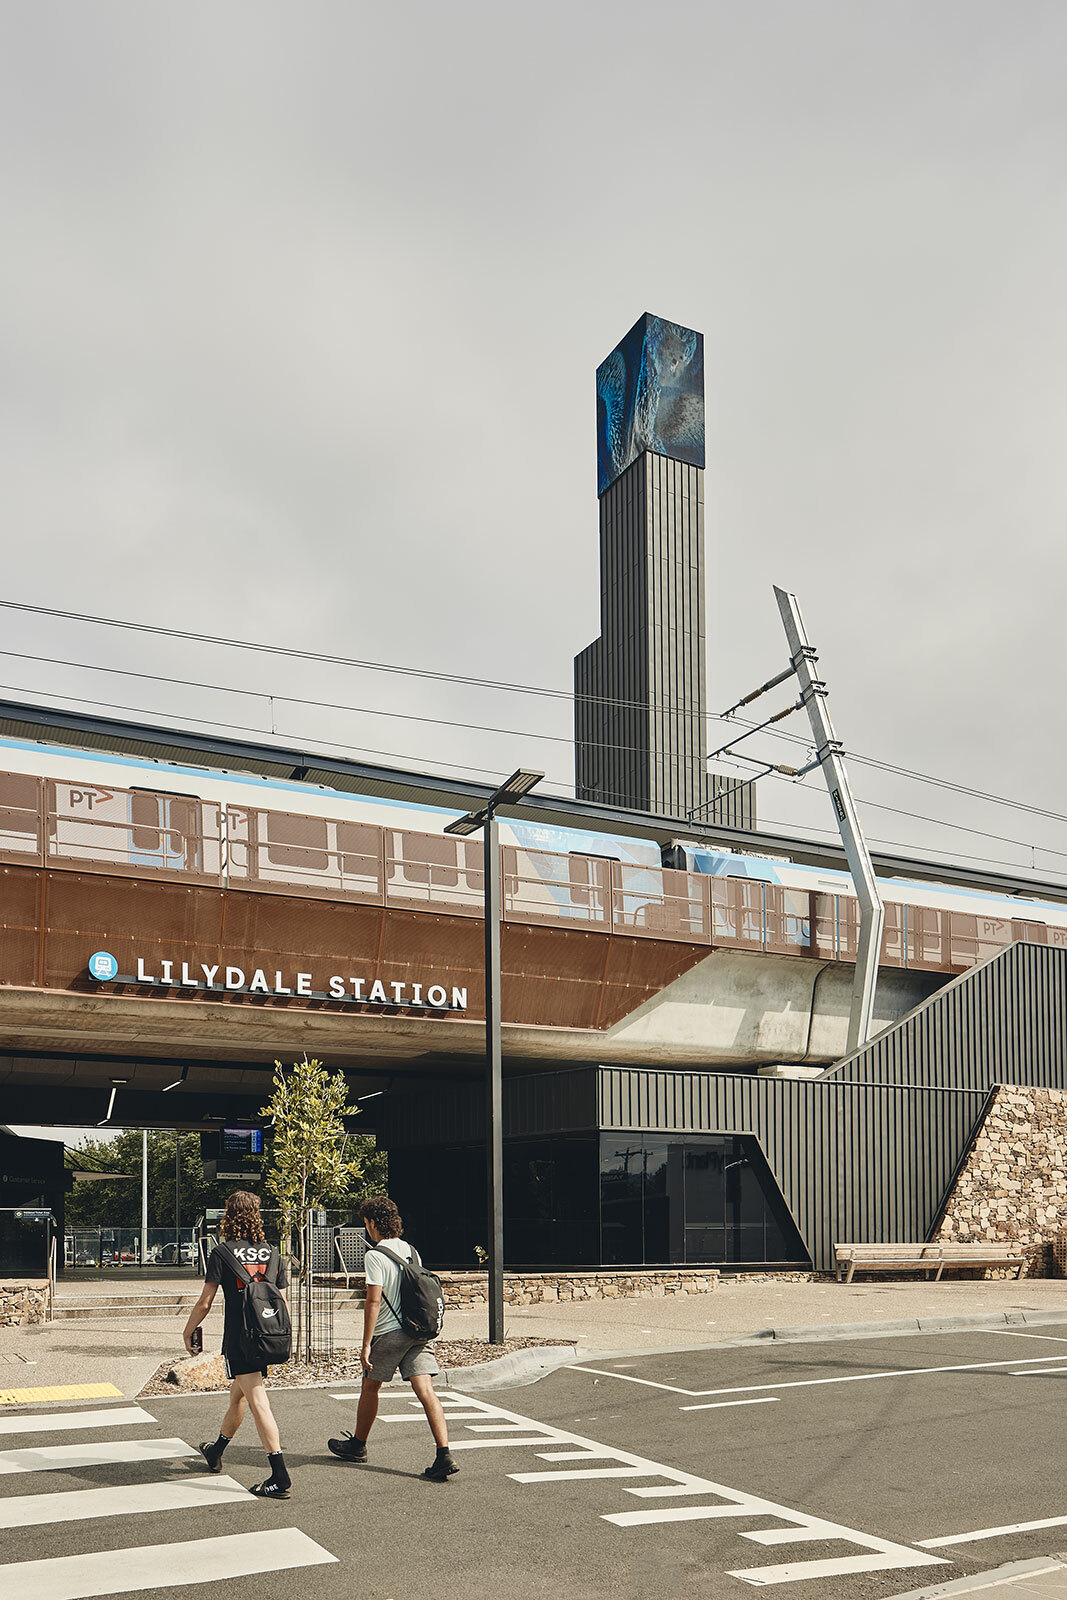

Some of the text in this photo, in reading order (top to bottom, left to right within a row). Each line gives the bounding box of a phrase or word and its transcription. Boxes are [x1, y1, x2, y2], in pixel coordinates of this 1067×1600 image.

[70, 790, 97, 810] PT
[983, 922, 997, 936] PT
[137, 958, 467, 1009] LILYDALE STATION
